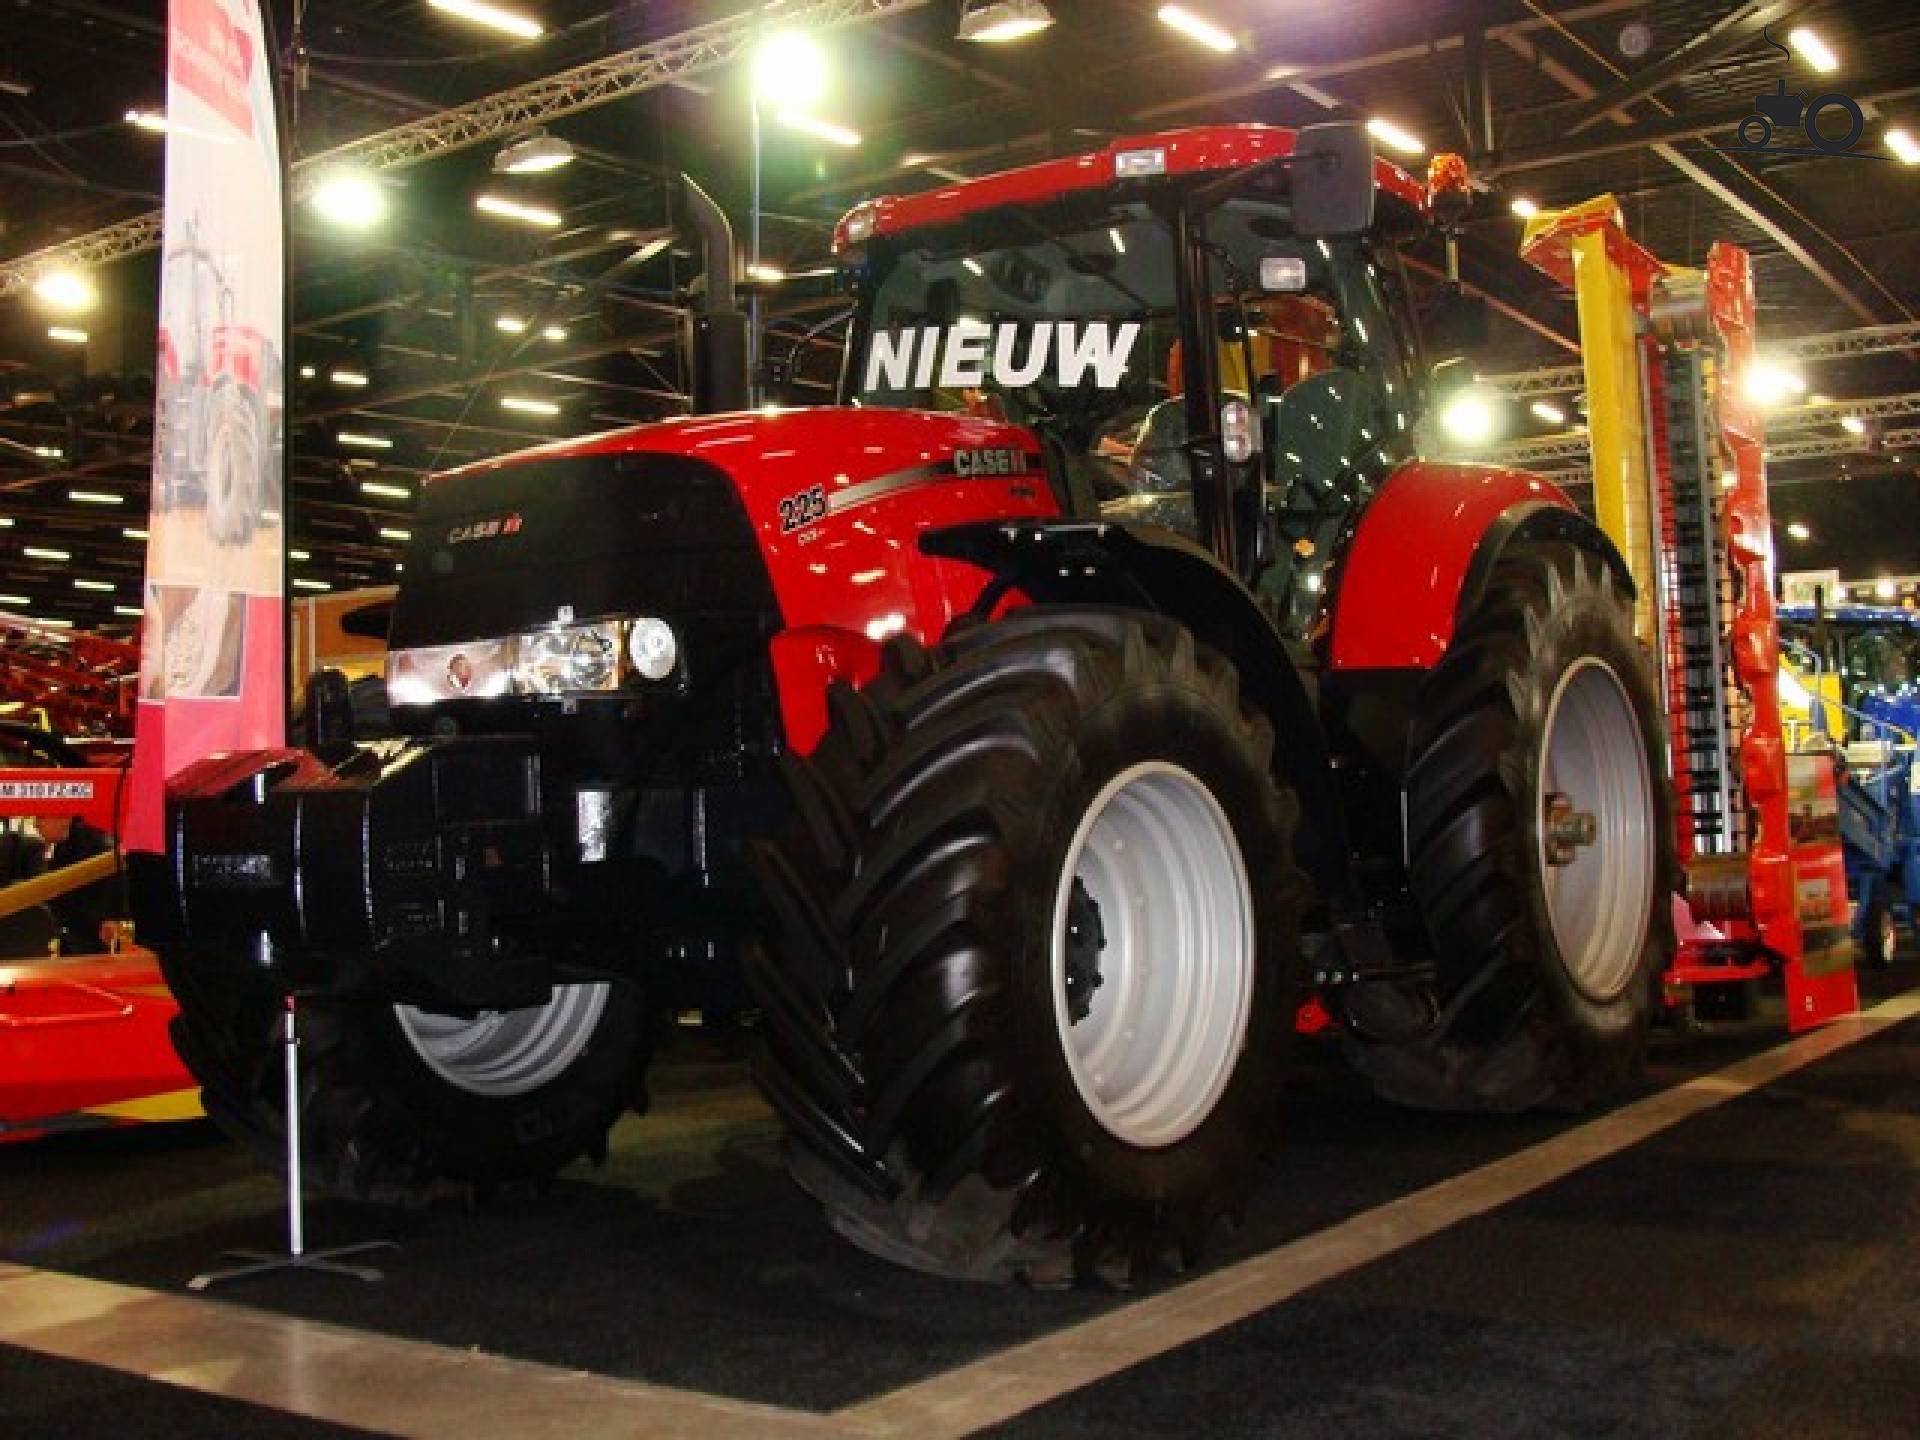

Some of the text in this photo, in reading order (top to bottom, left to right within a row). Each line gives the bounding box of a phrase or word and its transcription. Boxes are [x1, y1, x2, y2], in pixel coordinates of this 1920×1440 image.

[864, 315, 1140, 391] NIEUW
[954, 449, 1008, 475] CASE
[778, 484, 825, 535] 225
[448, 521, 499, 543] CASE
